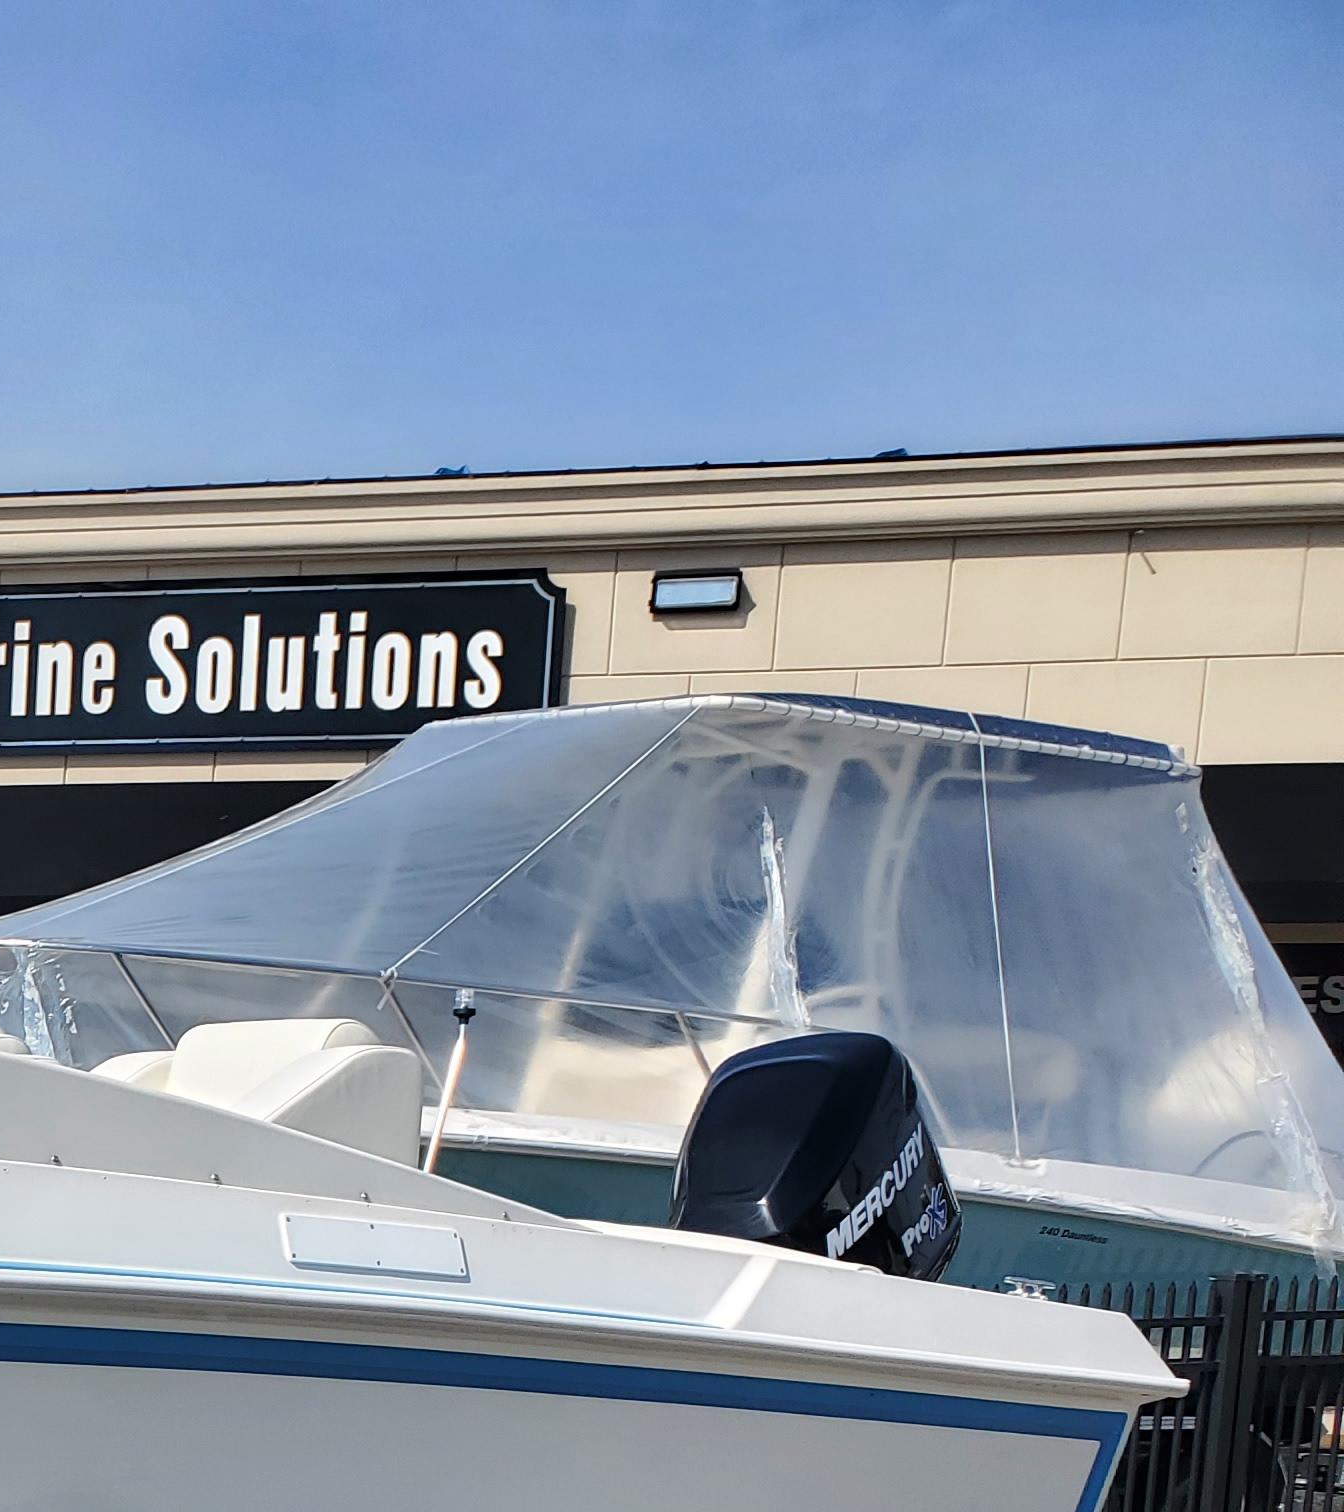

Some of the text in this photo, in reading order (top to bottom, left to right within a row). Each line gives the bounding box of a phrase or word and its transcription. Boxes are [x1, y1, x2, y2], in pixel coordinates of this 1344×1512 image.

[144, 611, 504, 715] Solutions
[826, 1120, 924, 1260] MERCURY
[1039, 1226, 1060, 1237] 240
